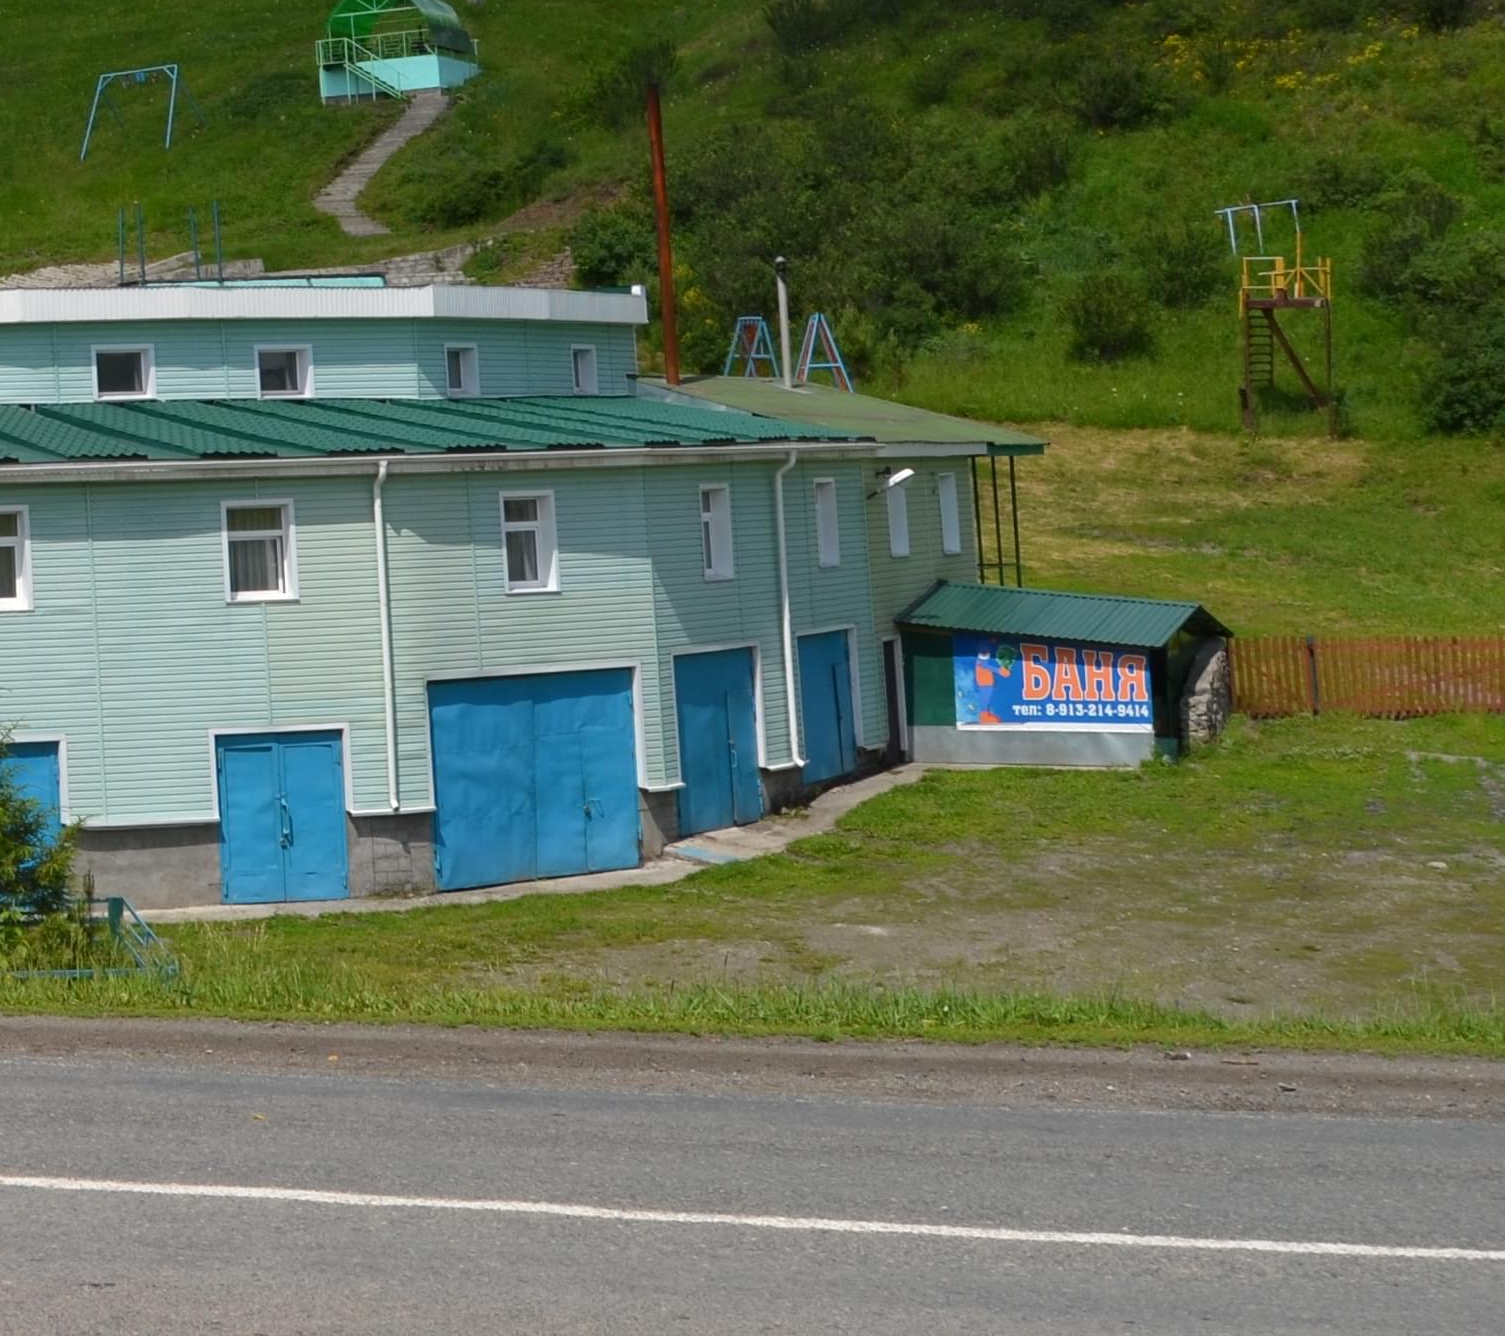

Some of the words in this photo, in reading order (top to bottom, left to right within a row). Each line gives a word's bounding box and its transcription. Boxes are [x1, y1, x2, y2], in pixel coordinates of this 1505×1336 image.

[1020, 644, 1148, 701] БАНЯ
[1013, 705, 1042, 716] тел:
[1046, 704, 1149, 717] 8-913-214-9414
